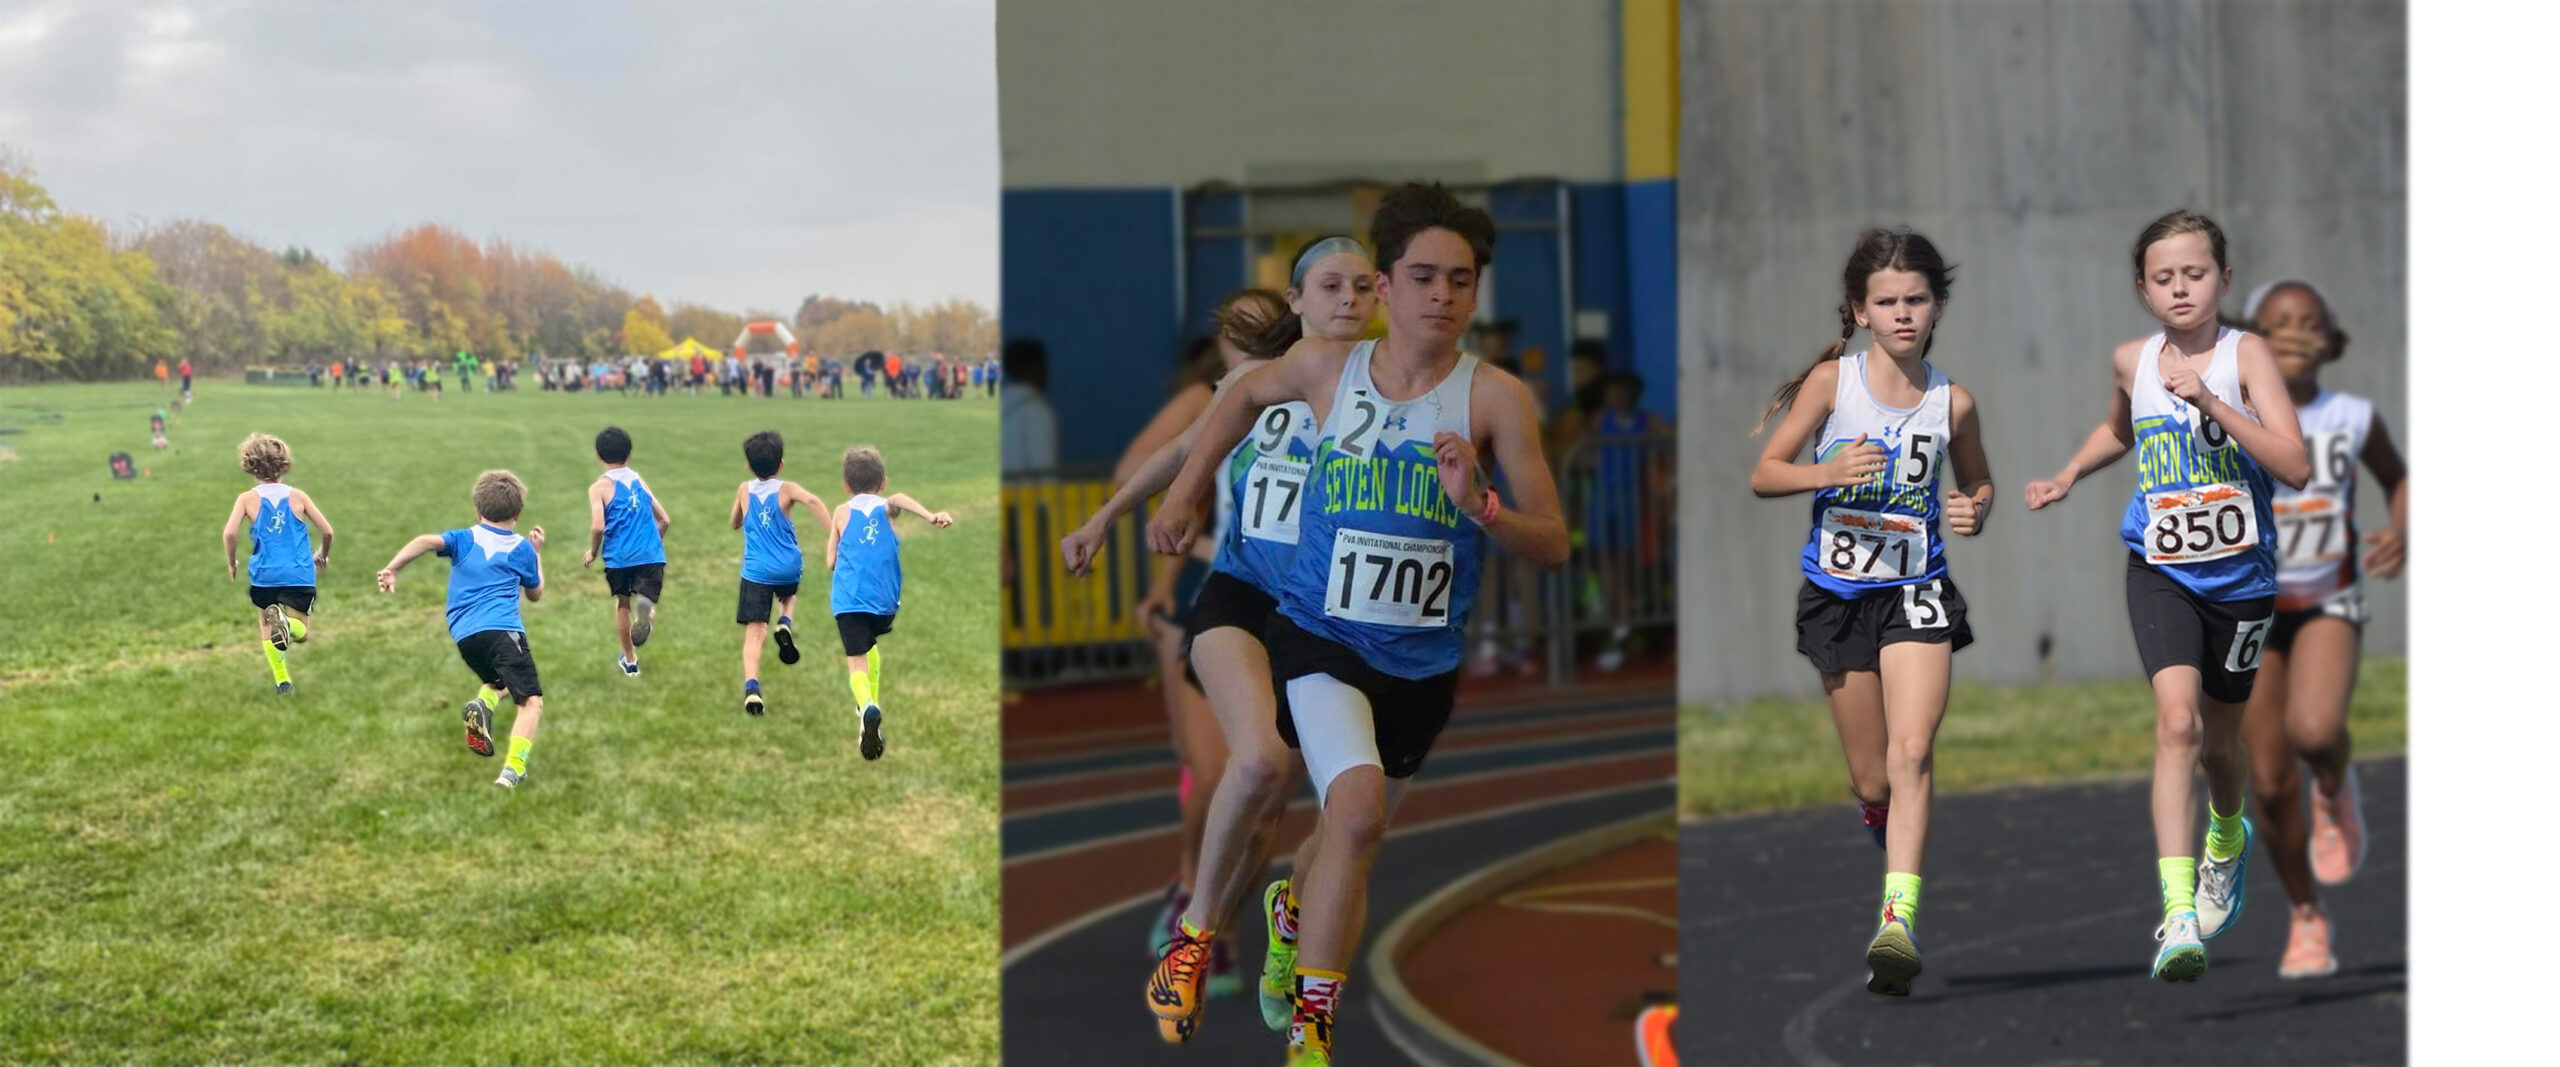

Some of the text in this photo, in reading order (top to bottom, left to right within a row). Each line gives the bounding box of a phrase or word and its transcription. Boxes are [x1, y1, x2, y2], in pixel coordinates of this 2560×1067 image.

[1259, 408, 1290, 452] 9
[1340, 401, 1376, 455] 2
[1906, 434, 1932, 483] 5
[2139, 431, 2182, 493] SEVEN
[1324, 456, 1389, 514] SEVEN
[1357, 536, 1401, 551] INVITATIONAL
[1830, 530, 1910, 577] 871
[2156, 504, 2246, 555] 850
[1339, 551, 1452, 617] 1702
[1913, 583, 1939, 626] 5
[2237, 622, 2264, 669] 6
